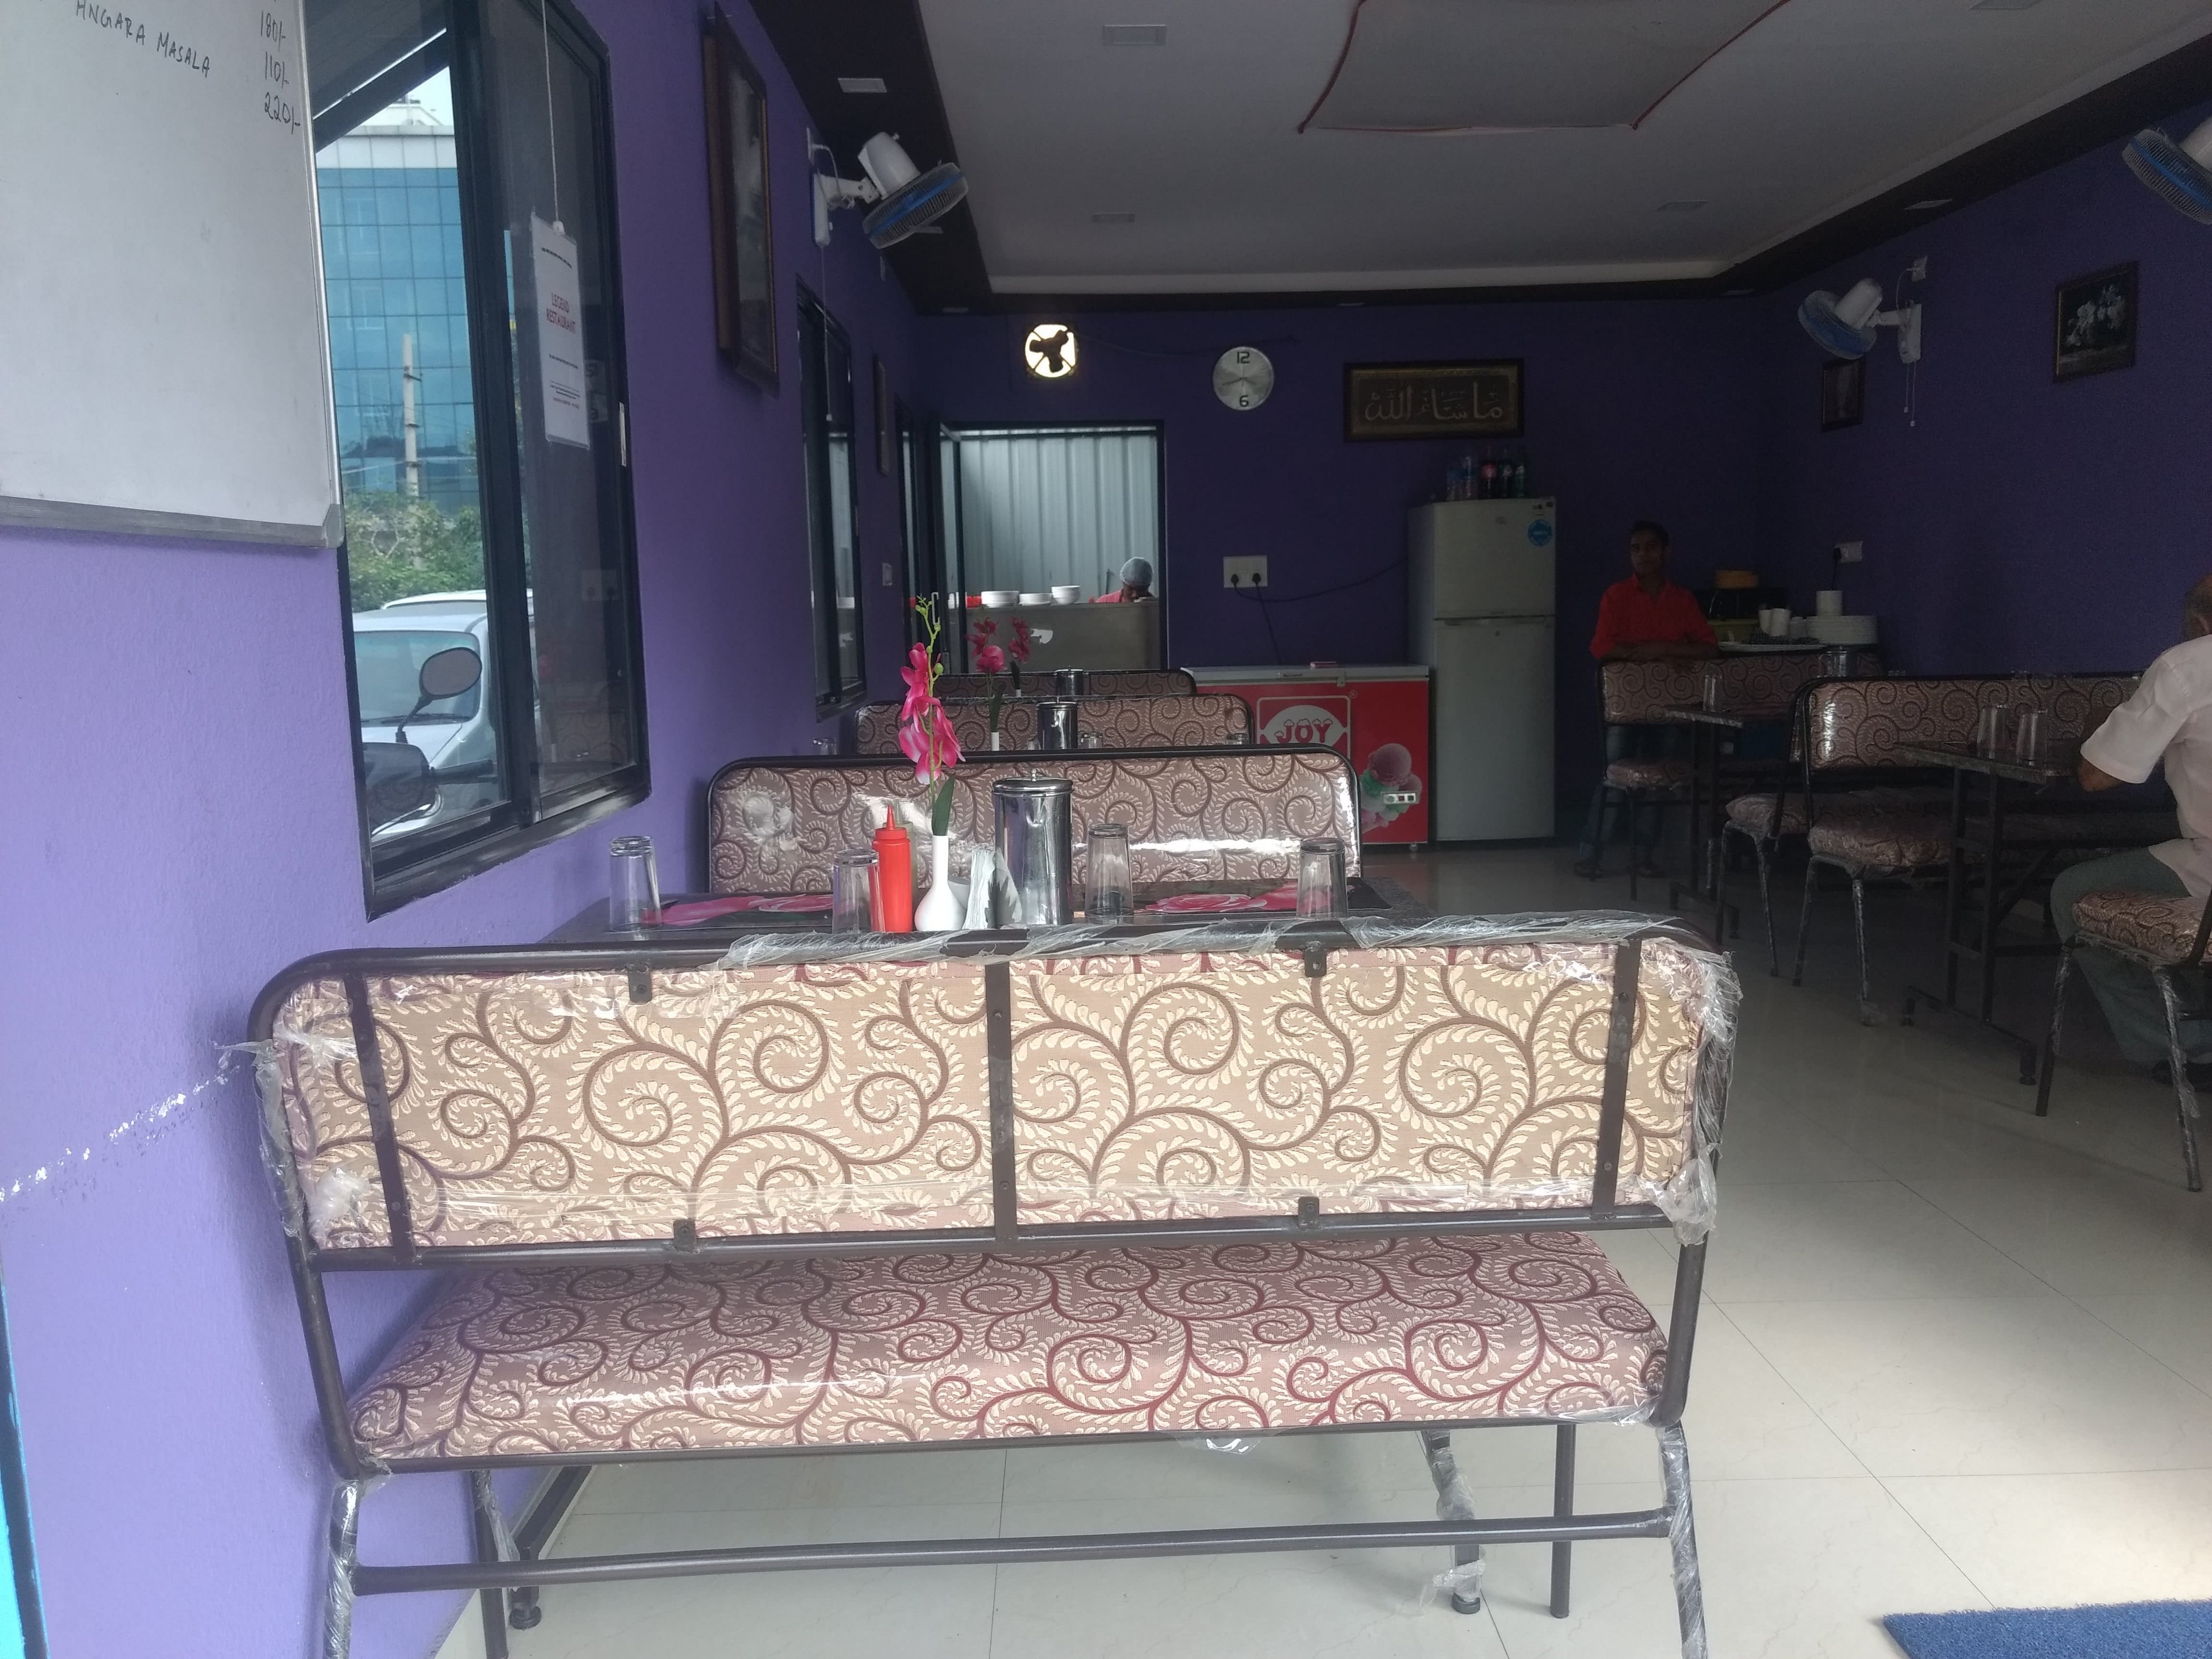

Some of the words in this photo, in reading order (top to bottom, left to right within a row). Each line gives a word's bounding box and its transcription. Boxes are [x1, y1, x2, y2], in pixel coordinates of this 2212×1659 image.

[156, 32, 210, 78] MASALA
[264, 92, 301, 135] 220/-
[551, 292, 570, 313] LEGEND
[546, 307, 576, 335] RESTAURANT
[1237, 351, 1250, 364] 12
[1239, 395, 1249, 407] 6
[1274, 719, 1333, 744] JOY
